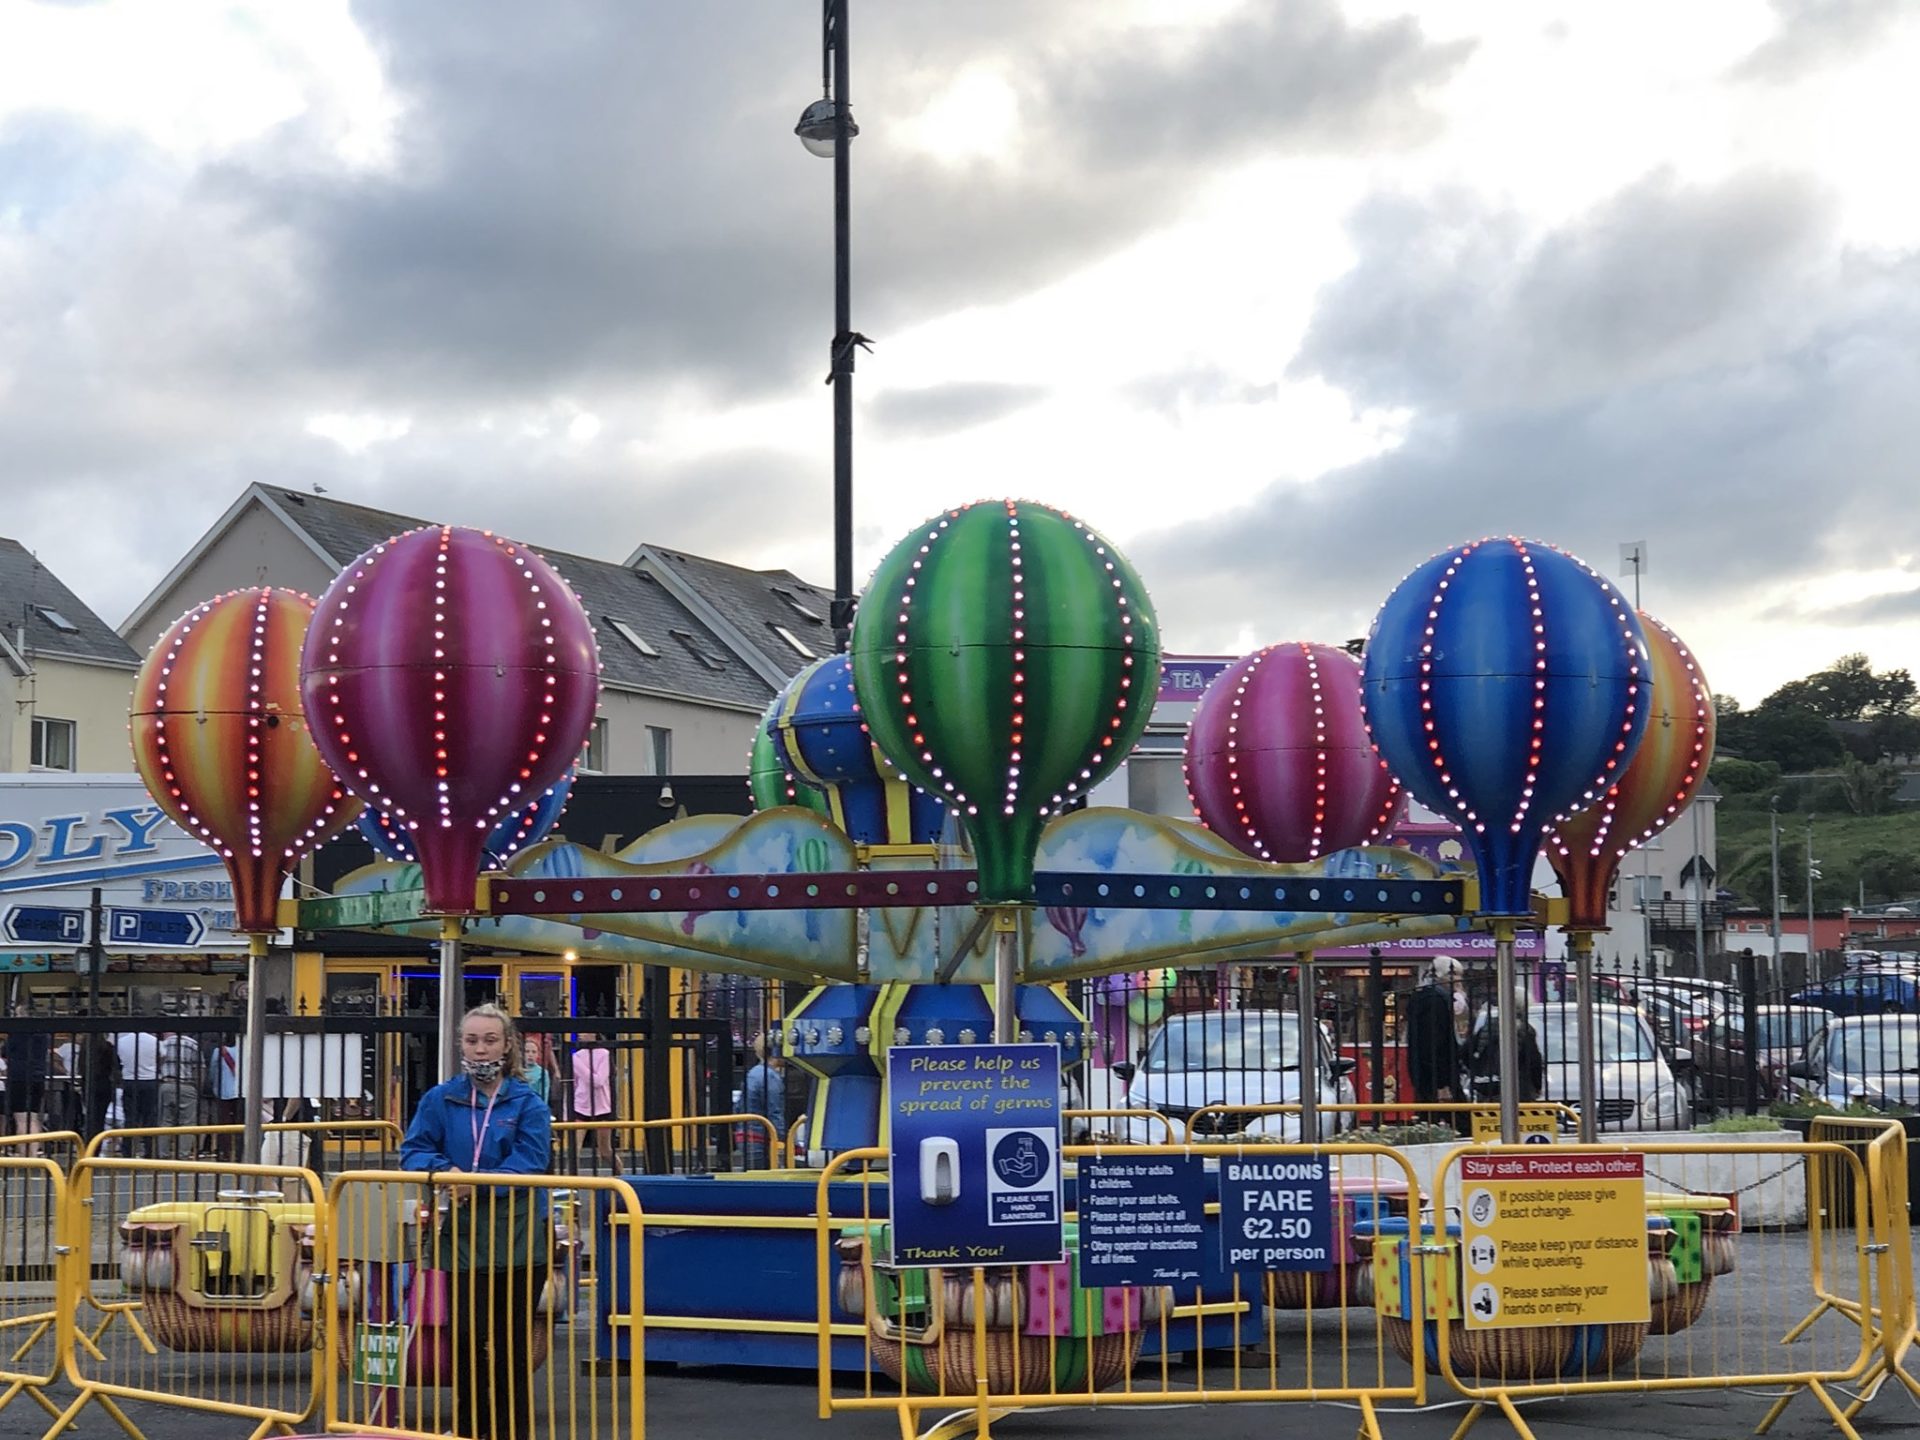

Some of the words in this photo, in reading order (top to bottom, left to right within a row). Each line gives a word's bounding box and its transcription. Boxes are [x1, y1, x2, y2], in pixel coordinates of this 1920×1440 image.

[1172, 672, 1203, 689] TEA
[142, 879, 233, 901] FRESH
[63, 916, 79, 937] P
[119, 915, 137, 936] P
[1400, 939, 1425, 949] COLD
[1428, 938, 1463, 948] DRINKS
[911, 1057, 967, 1072] Please
[974, 1055, 1014, 1073] help
[1021, 1058, 1041, 1069] us
[920, 1077, 993, 1095] prevent
[1001, 1075, 1030, 1089] the
[900, 1096, 961, 1116] spread
[970, 1095, 989, 1110] of
[995, 1096, 1053, 1114] germs
[1480, 1124, 1524, 1132] PLEE
[1090, 1165, 1108, 1176] This
[1109, 1165, 1125, 1176] ride
[1126, 1165, 1134, 1175] is
[1135, 1165, 1147, 1175] for
[1148, 1165, 1174, 1175] adults
[1228, 1163, 1323, 1181] BALLOONS
[1466, 1161, 1494, 1177] Stay
[1497, 1160, 1527, 1173] safe.
[1529, 1160, 1573, 1173] Protect
[1575, 1160, 1605, 1172] each
[1607, 1159, 1640, 1172] other.
[1090, 1179, 1097, 1189] &
[1097, 1178, 1133, 1189] children.
[996, 1195, 1029, 1203] PLEASE
[1031, 1194, 1050, 1202] USE
[1090, 1195, 1118, 1205] Fasten
[1119, 1196, 1138, 1207] your
[1139, 1195, 1157, 1205] seat
[1157, 1194, 1181, 1205] belts.
[1243, 1190, 1314, 1211] FARE
[1500, 1190, 1507, 1201] If
[1510, 1189, 1556, 1204] possible
[1558, 1189, 1592, 1203] please
[1595, 1188, 1616, 1203] give
[1000, 1212, 1047, 1220] SANITISER
[1090, 1211, 1118, 1222] Please
[1119, 1211, 1137, 1223] stay
[1138, 1211, 1165, 1221] seated
[1166, 1211, 1175, 1220] at
[1175, 1210, 1186, 1220] all
[1500, 1207, 1529, 1218] exact
[1531, 1206, 1575, 1220] change.
[1090, 1224, 1114, 1235] times
[1114, 1224, 1136, 1234] when
[1137, 1223, 1154, 1234] ride
[1154, 1223, 1162, 1233] is
[1163, 1223, 1172, 1233] in
[1172, 1222, 1203, 1233] motion.
[1242, 1217, 1311, 1239] €2.50
[1090, 1240, 1113, 1253] Obey
[1113, 1240, 1149, 1253] operator
[1149, 1239, 1198, 1250] instructions
[1501, 1240, 1537, 1252] Please
[1539, 1239, 1566, 1252] keep
[1568, 1240, 1593, 1253] your
[1594, 1236, 1639, 1249] distance
[903, 1246, 960, 1259] Thank
[966, 1245, 1005, 1258] You!
[1091, 1254, 1100, 1264] at
[1101, 1253, 1112, 1264] all
[1112, 1253, 1137, 1264] times.
[1230, 1250, 1259, 1264] per
[1263, 1247, 1325, 1264] person
[1501, 1256, 1530, 1268] while
[1531, 1255, 1585, 1269] queueing.
[1152, 1268, 1180, 1278] Thank
[1502, 1286, 1539, 1298] Please
[1541, 1285, 1582, 1297] sanitise
[1584, 1285, 1608, 1299] your
[1503, 1303, 1536, 1315] hands
[1538, 1303, 1553, 1314] on
[1554, 1301, 1585, 1315] entry.
[364, 1357, 397, 1376] ONY
